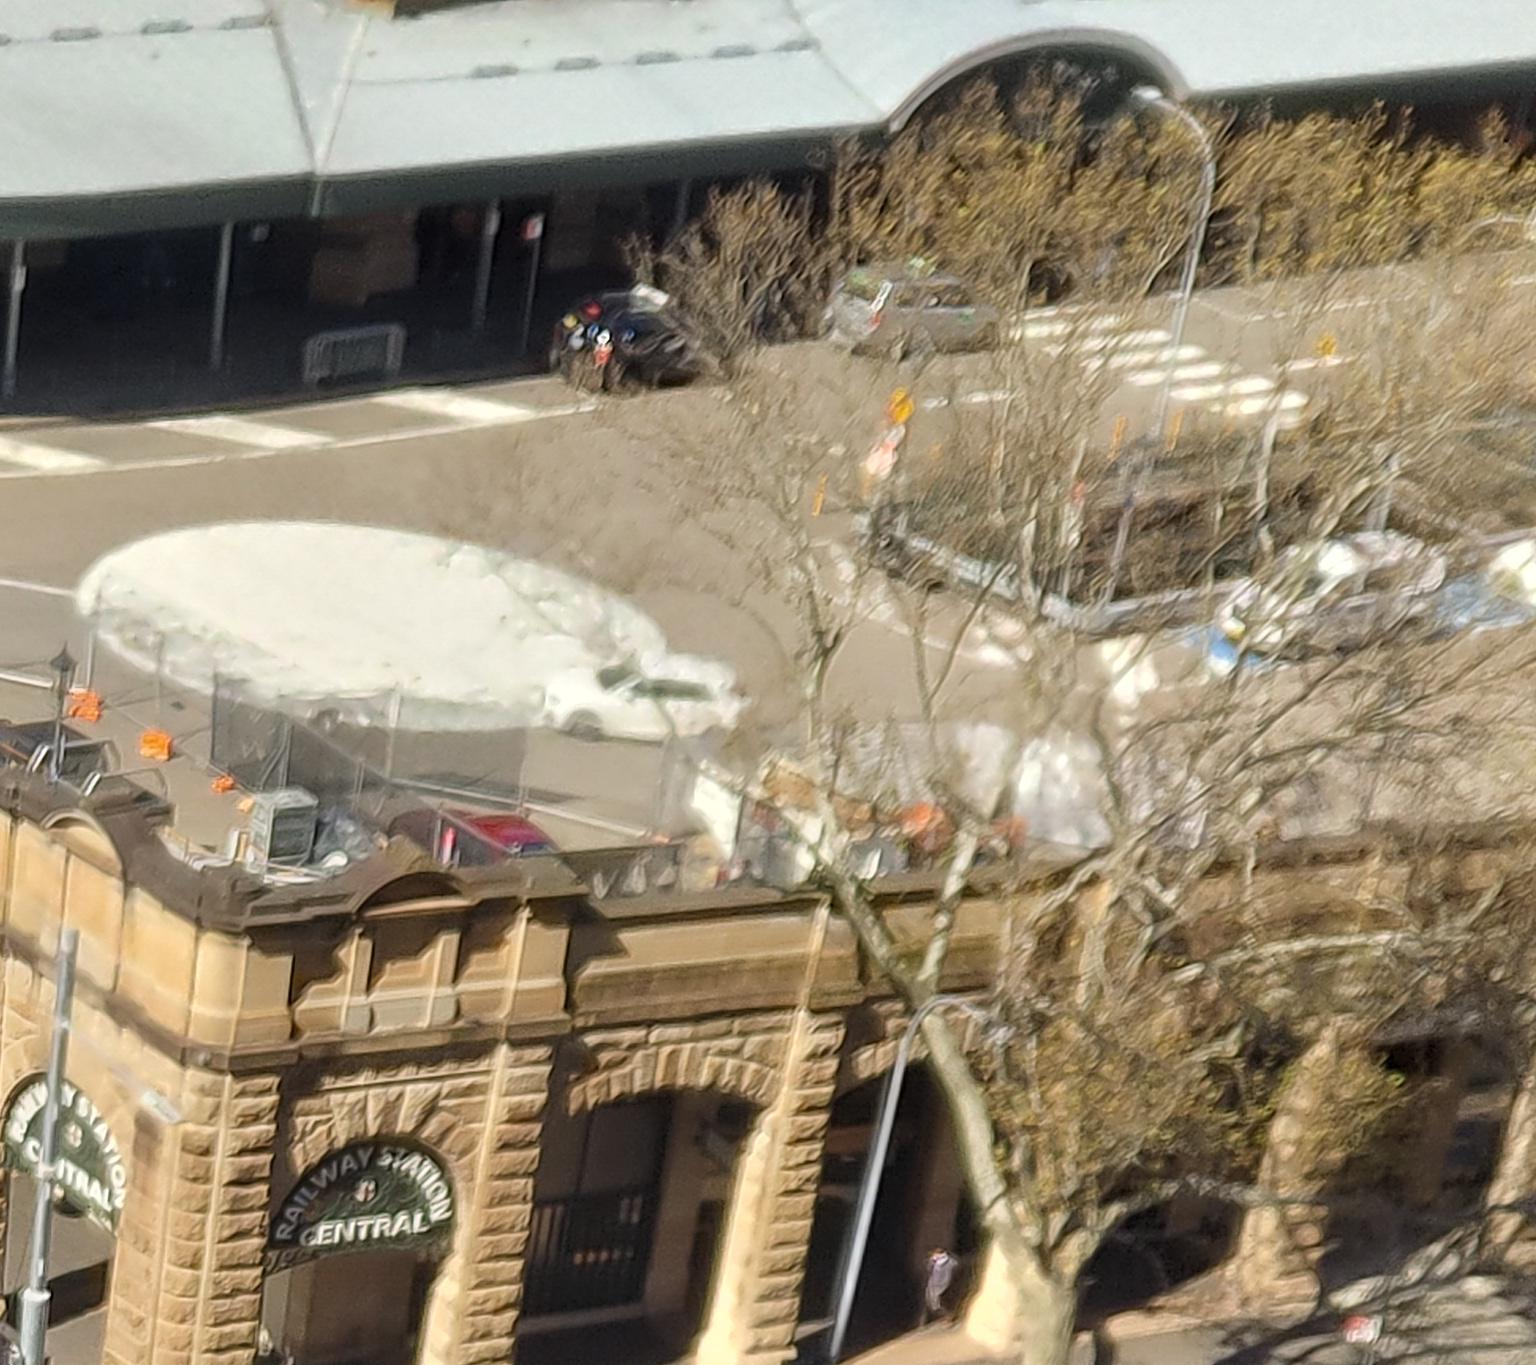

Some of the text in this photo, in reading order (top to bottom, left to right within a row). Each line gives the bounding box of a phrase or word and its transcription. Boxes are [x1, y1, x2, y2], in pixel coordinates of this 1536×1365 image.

[275, 1146, 454, 1241] RAILWAY STATION
[299, 1209, 433, 1247] CENTRAL
